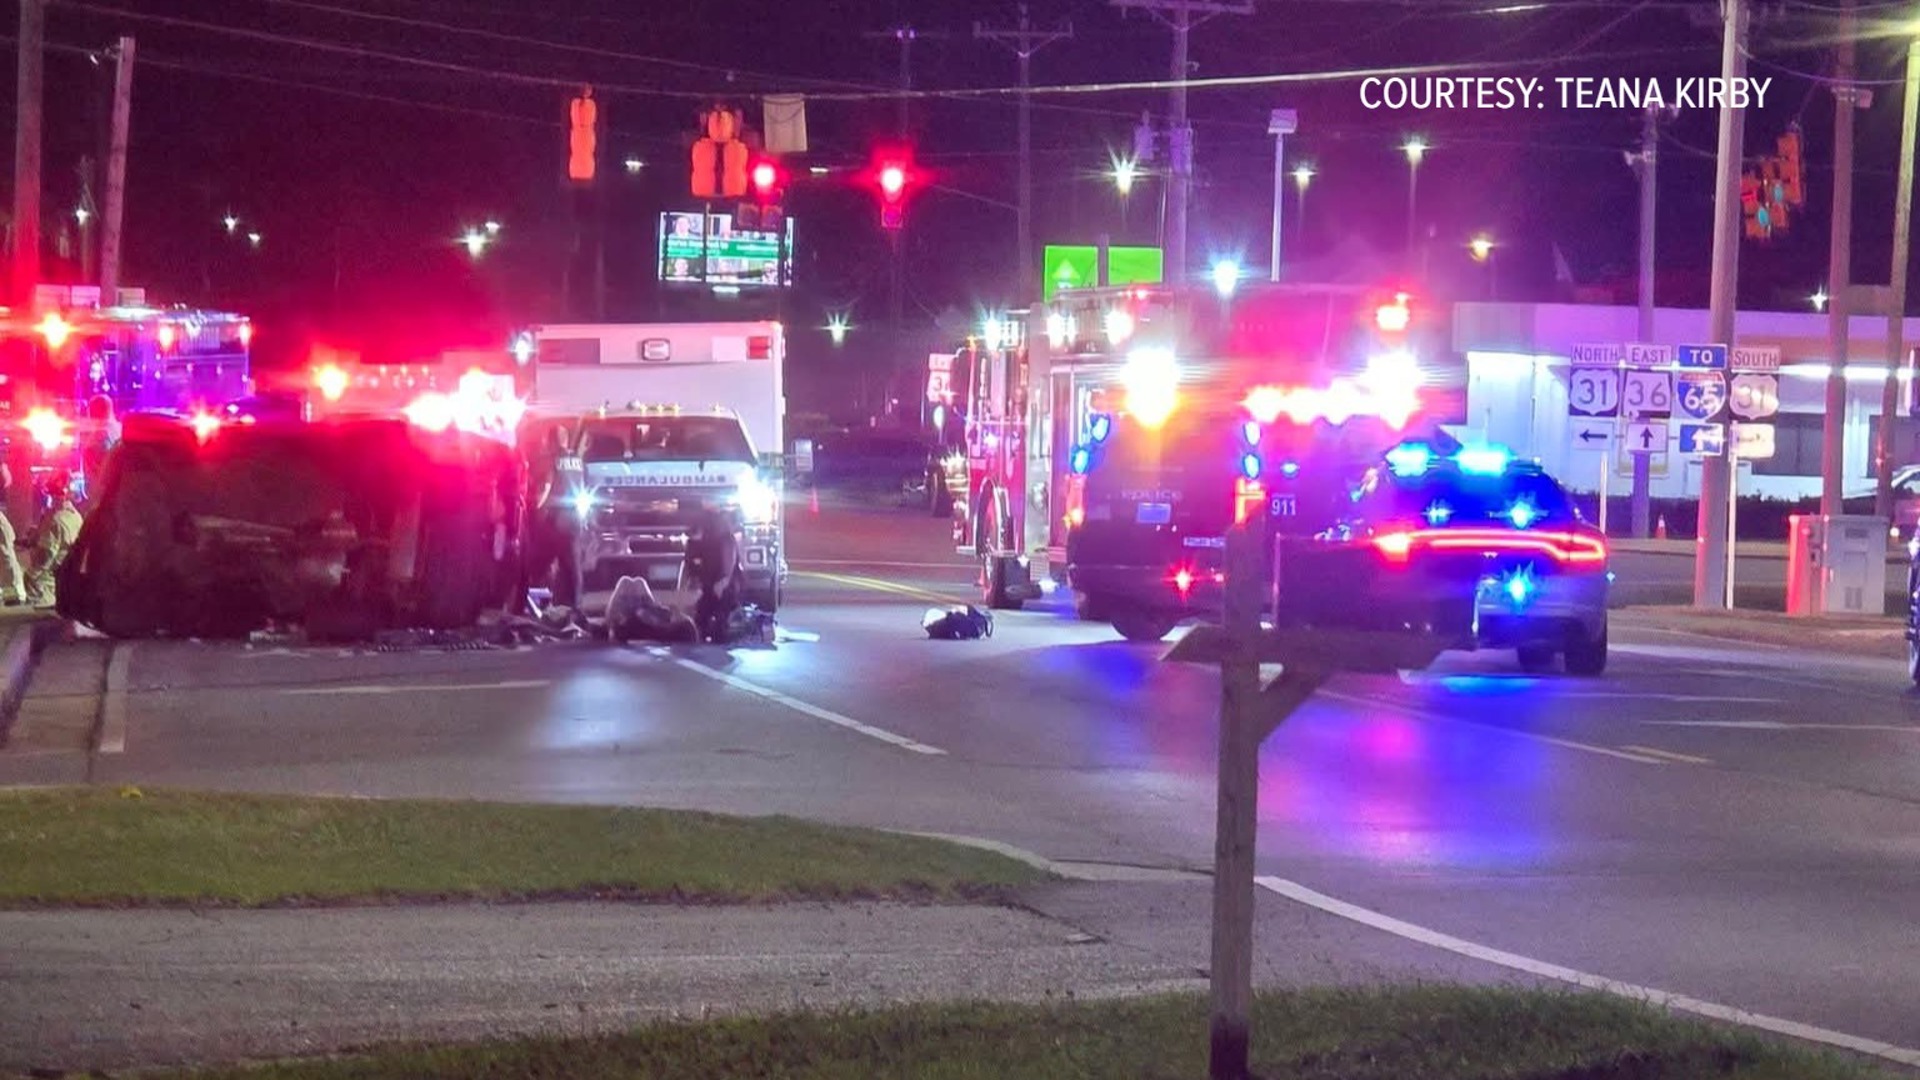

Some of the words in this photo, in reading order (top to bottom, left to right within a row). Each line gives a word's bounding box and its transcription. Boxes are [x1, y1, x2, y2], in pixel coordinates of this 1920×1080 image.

[1573, 346, 1618, 361] NORTH
[1632, 347, 1664, 363] EAST
[1689, 349, 1713, 364] TO
[1734, 351, 1778, 366] SOUTH
[1578, 378, 1607, 405] 31
[1628, 380, 1667, 406] 36
[1684, 384, 1719, 412] 65
[1737, 383, 1765, 410] 31
[1121, 489, 1183, 501] POLICE
[1272, 499, 1296, 516] 911
